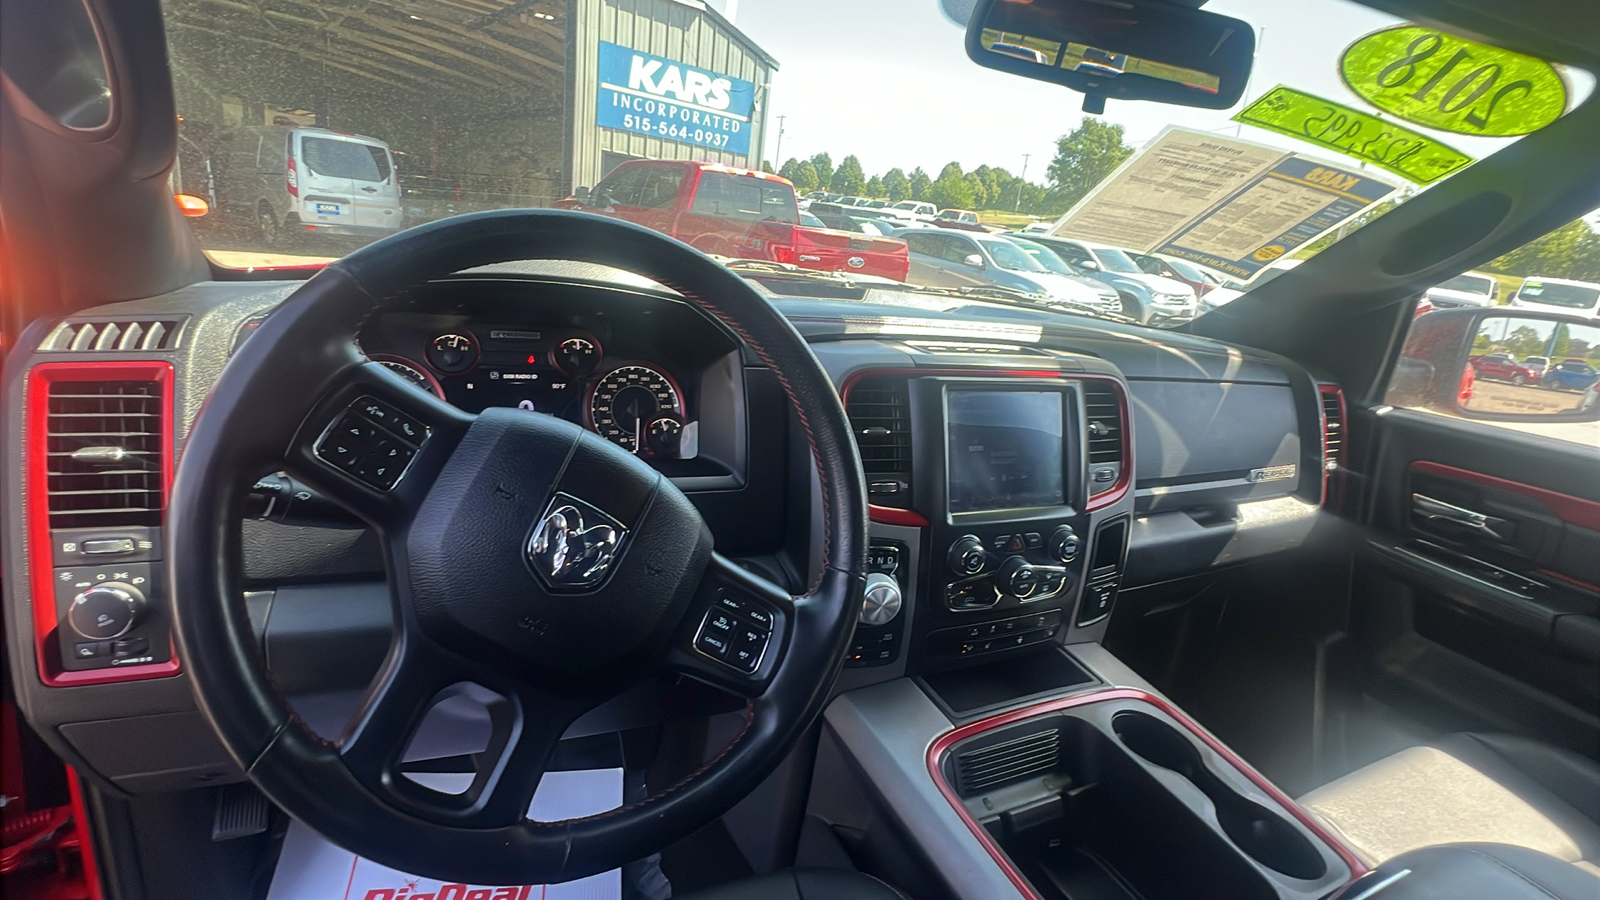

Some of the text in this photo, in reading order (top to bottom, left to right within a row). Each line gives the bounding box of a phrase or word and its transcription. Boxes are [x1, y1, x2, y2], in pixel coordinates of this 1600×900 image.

[628, 54, 732, 110] KARS
[613, 92, 740, 133] INCORPORATED
[623, 114, 730, 147] 515-564-0937
